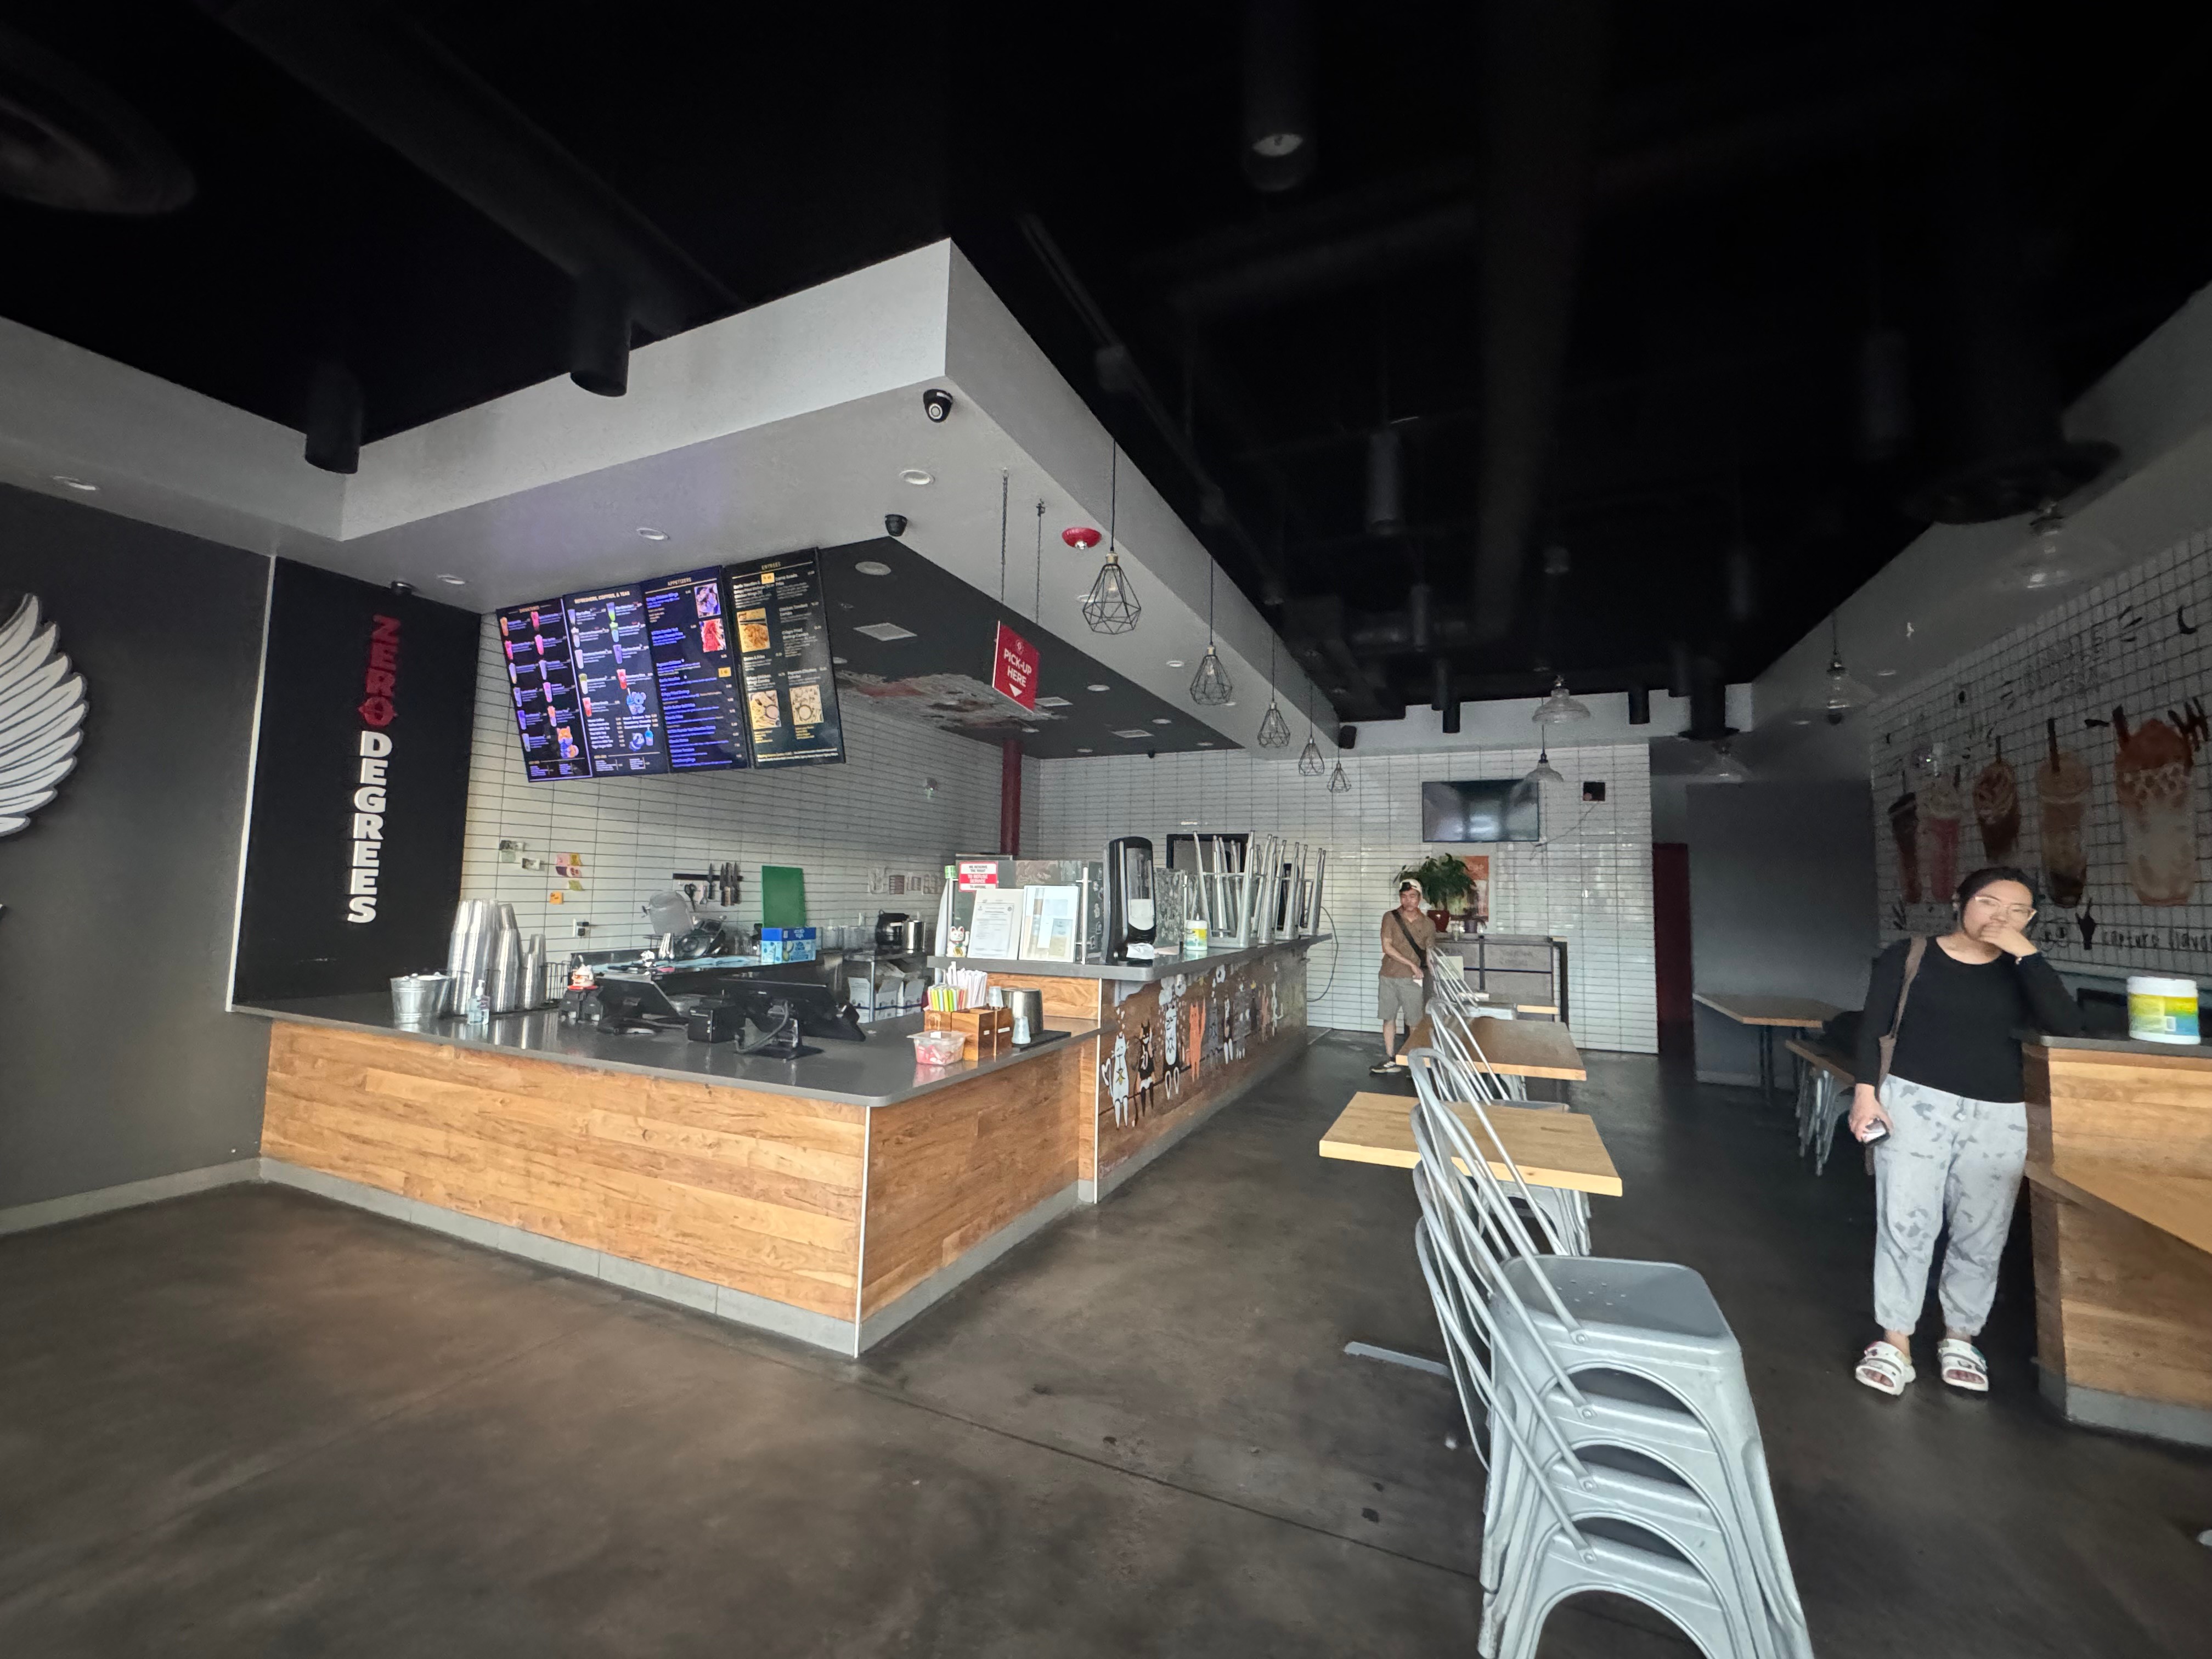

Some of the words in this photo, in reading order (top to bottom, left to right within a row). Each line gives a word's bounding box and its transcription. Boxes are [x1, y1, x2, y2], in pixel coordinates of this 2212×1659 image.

[668, 577, 691, 586] APPETIZERS
[358, 614, 402, 727] ZERO
[1004, 648, 1031, 675] PICK-UP
[1008, 665, 1027, 687] HERE
[347, 730, 393, 924] DEGREES
